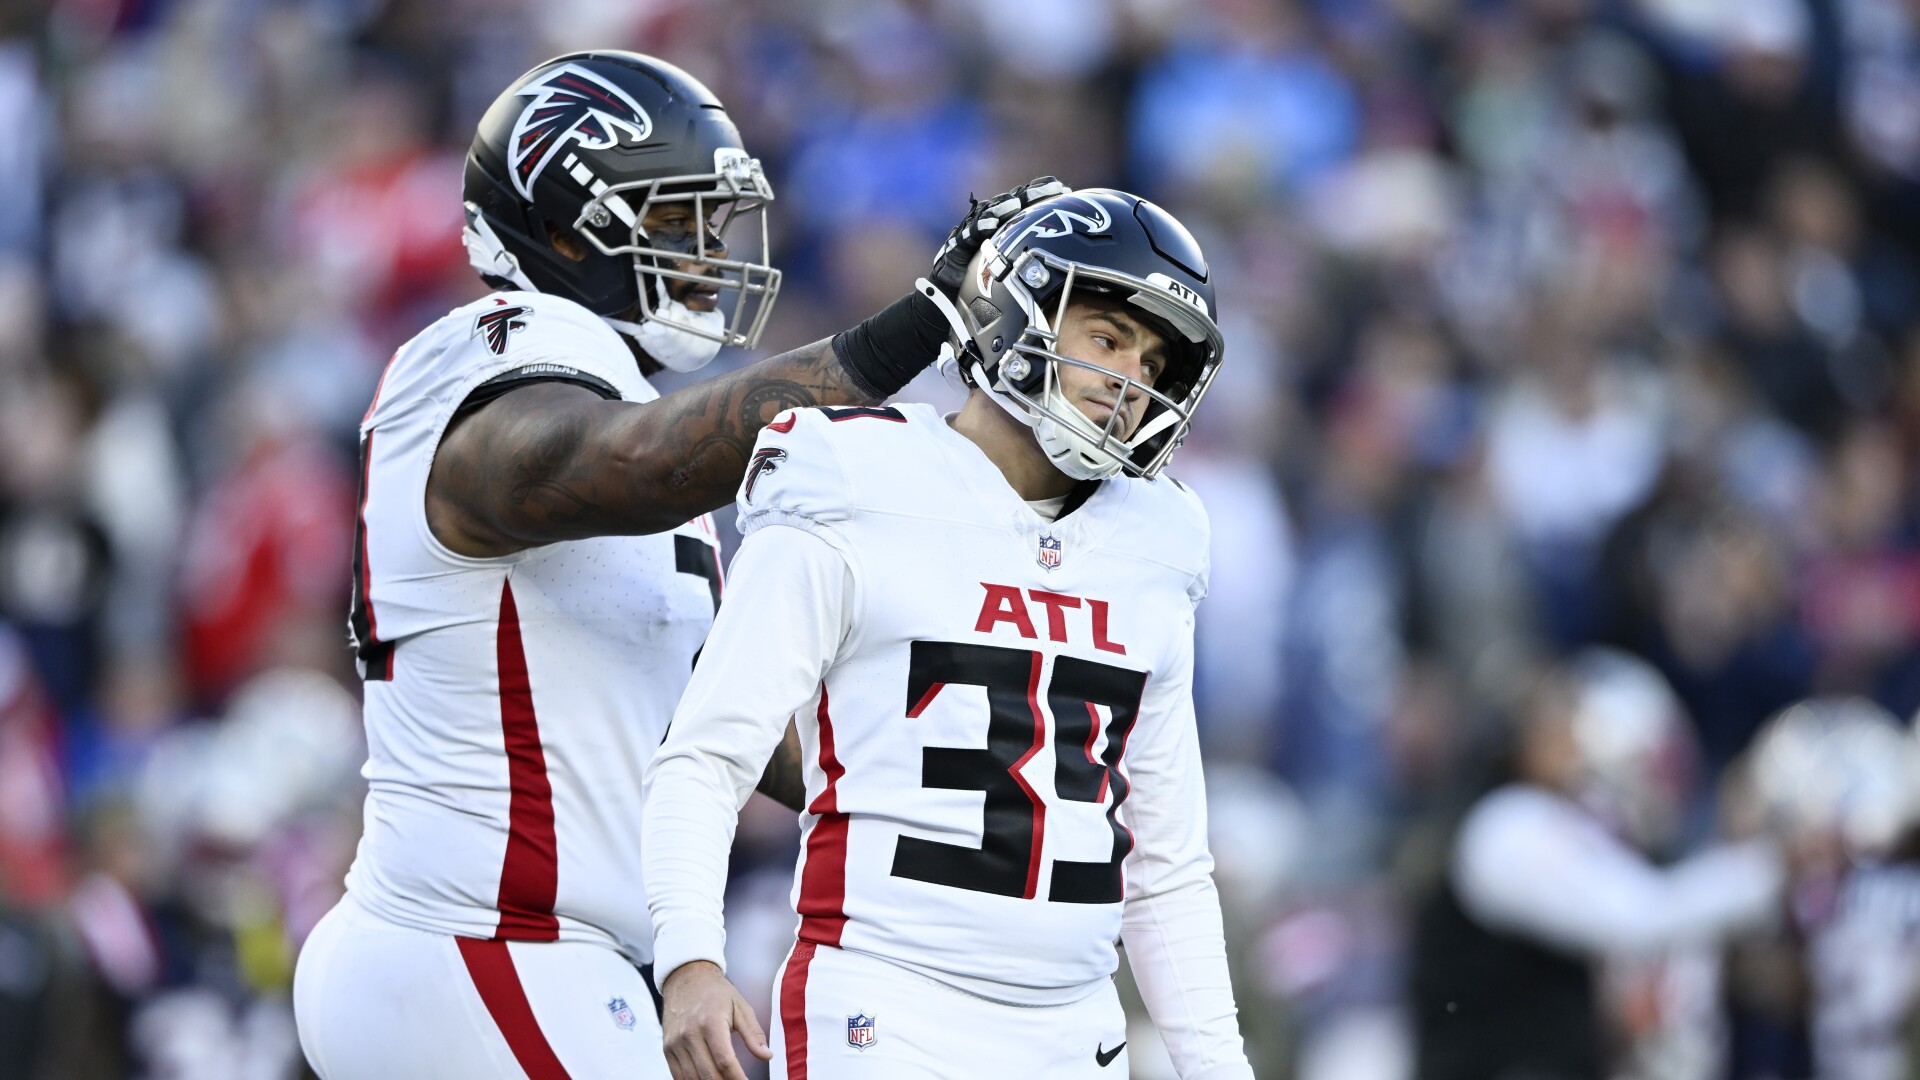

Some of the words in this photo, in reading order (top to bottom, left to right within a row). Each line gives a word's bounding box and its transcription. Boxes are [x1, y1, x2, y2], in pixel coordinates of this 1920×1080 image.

[1168, 280, 1200, 308] ATL
[1041, 549, 1060, 565] NFL
[974, 582, 1127, 656] ATL
[890, 640, 1153, 905] 39
[850, 1028, 873, 1043] NFL
